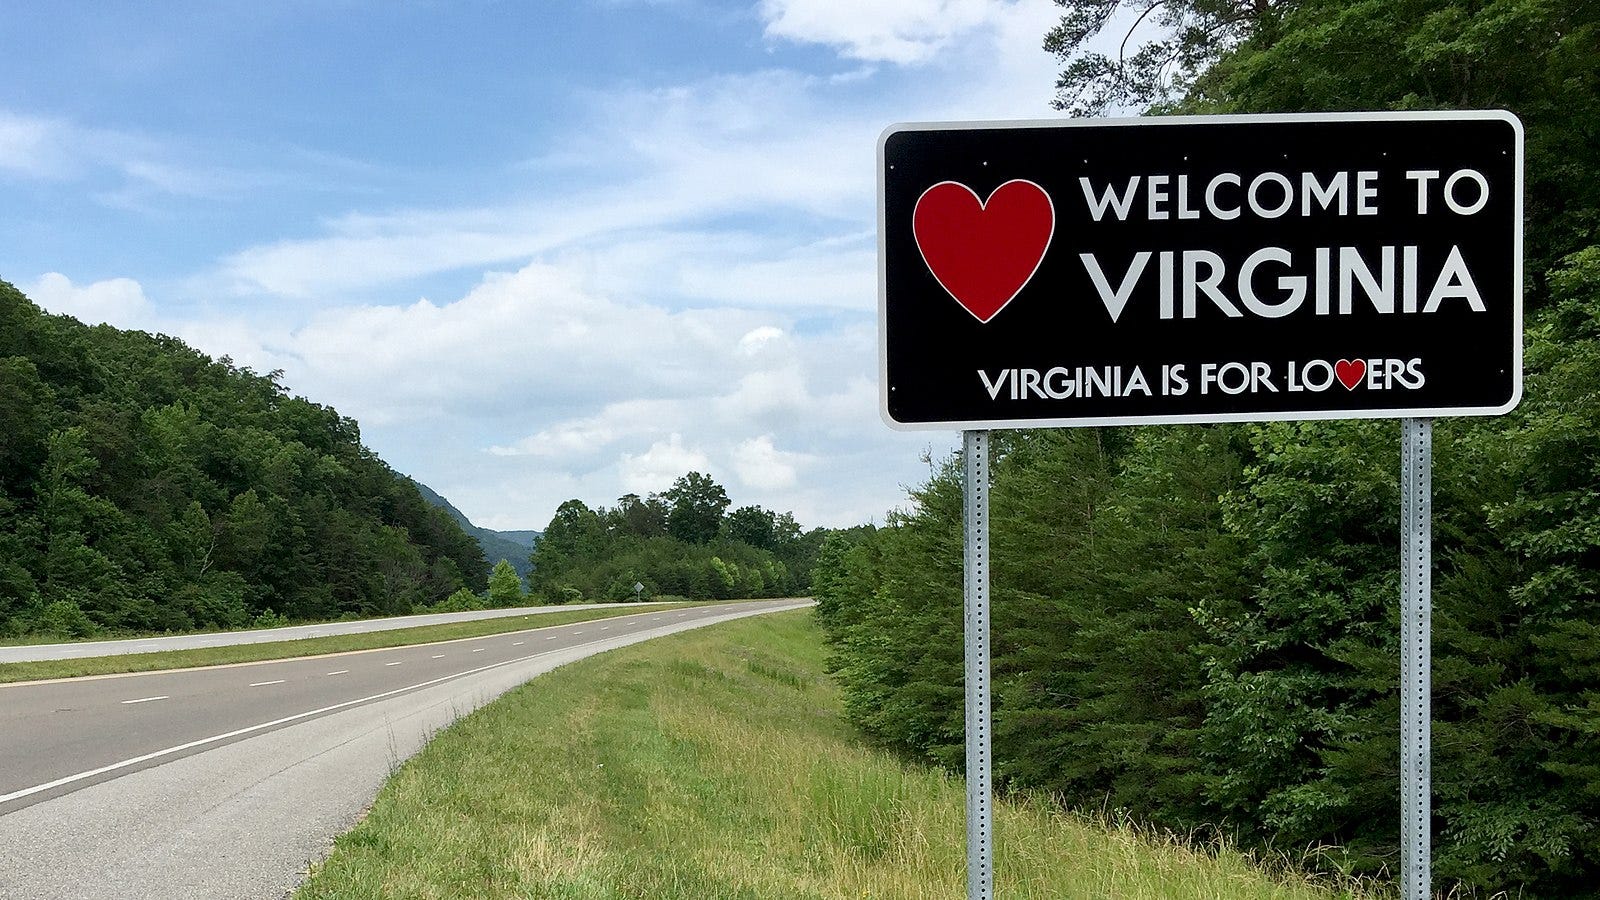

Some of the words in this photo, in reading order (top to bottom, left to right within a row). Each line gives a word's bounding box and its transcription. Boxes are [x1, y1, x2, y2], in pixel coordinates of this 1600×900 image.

[1079, 170, 1379, 222] WELCOME
[1406, 168, 1490, 216] TO
[1079, 244, 1487, 324] VIRGINIA
[977, 364, 1153, 401] VIRGINIA
[1162, 363, 1189, 396] IS
[1200, 361, 1280, 395] FOR
